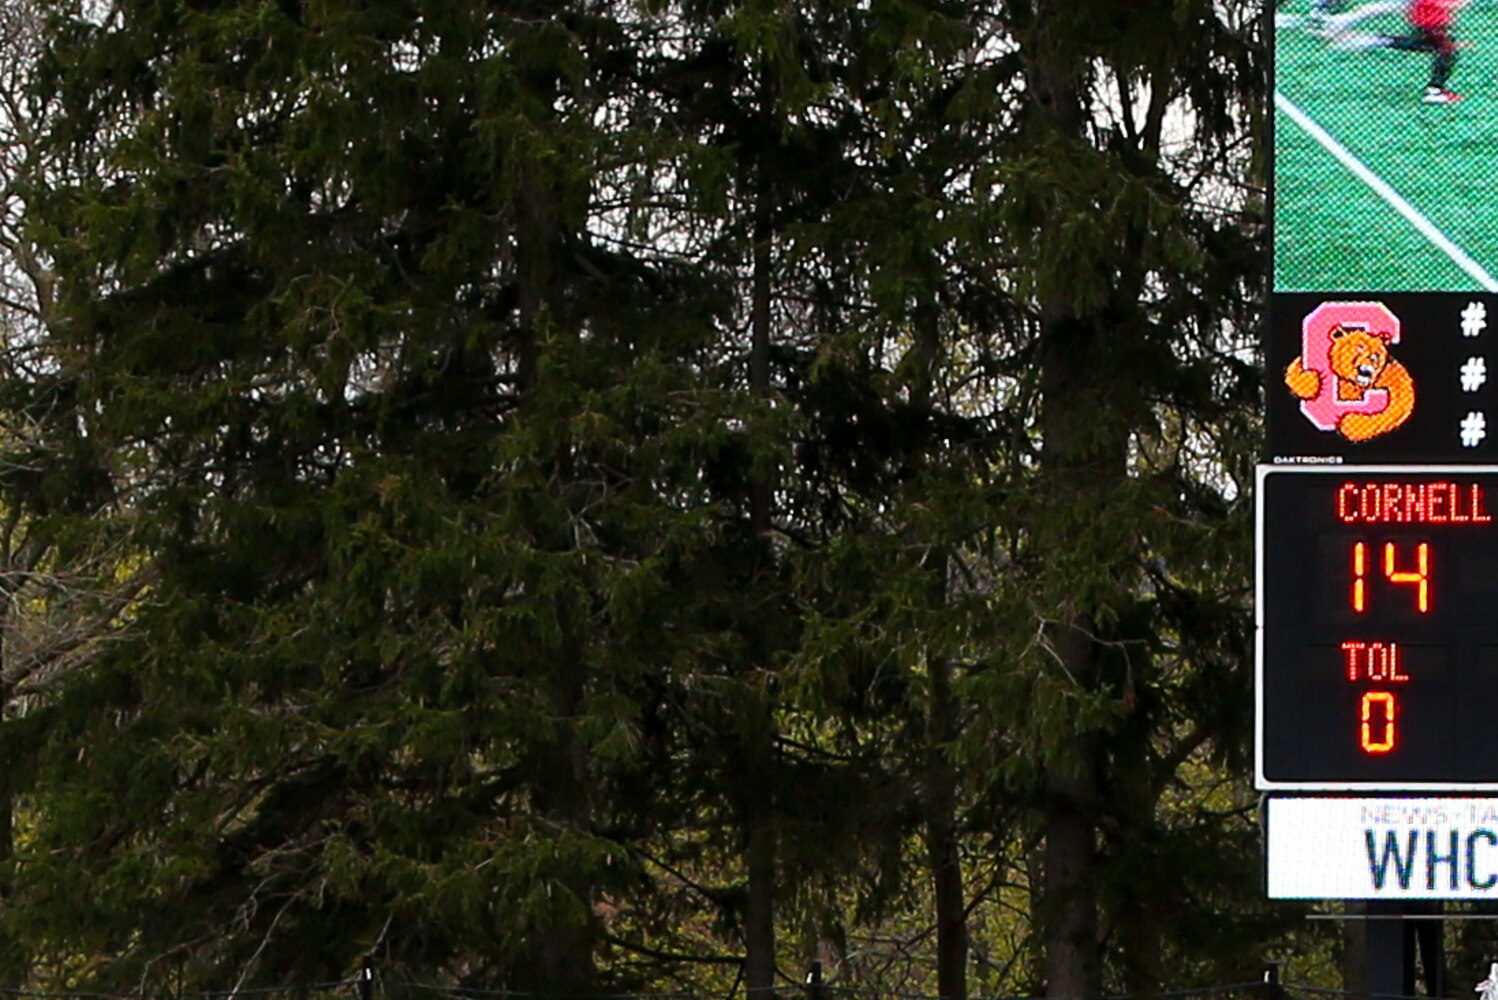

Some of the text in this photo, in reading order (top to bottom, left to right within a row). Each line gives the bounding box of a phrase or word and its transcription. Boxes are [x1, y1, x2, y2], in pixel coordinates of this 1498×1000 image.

[1338, 481, 1491, 524] CORNELL
[1352, 541, 1430, 613] 14
[1341, 641, 1409, 682] TOL
[1360, 690, 1400, 755] 0
